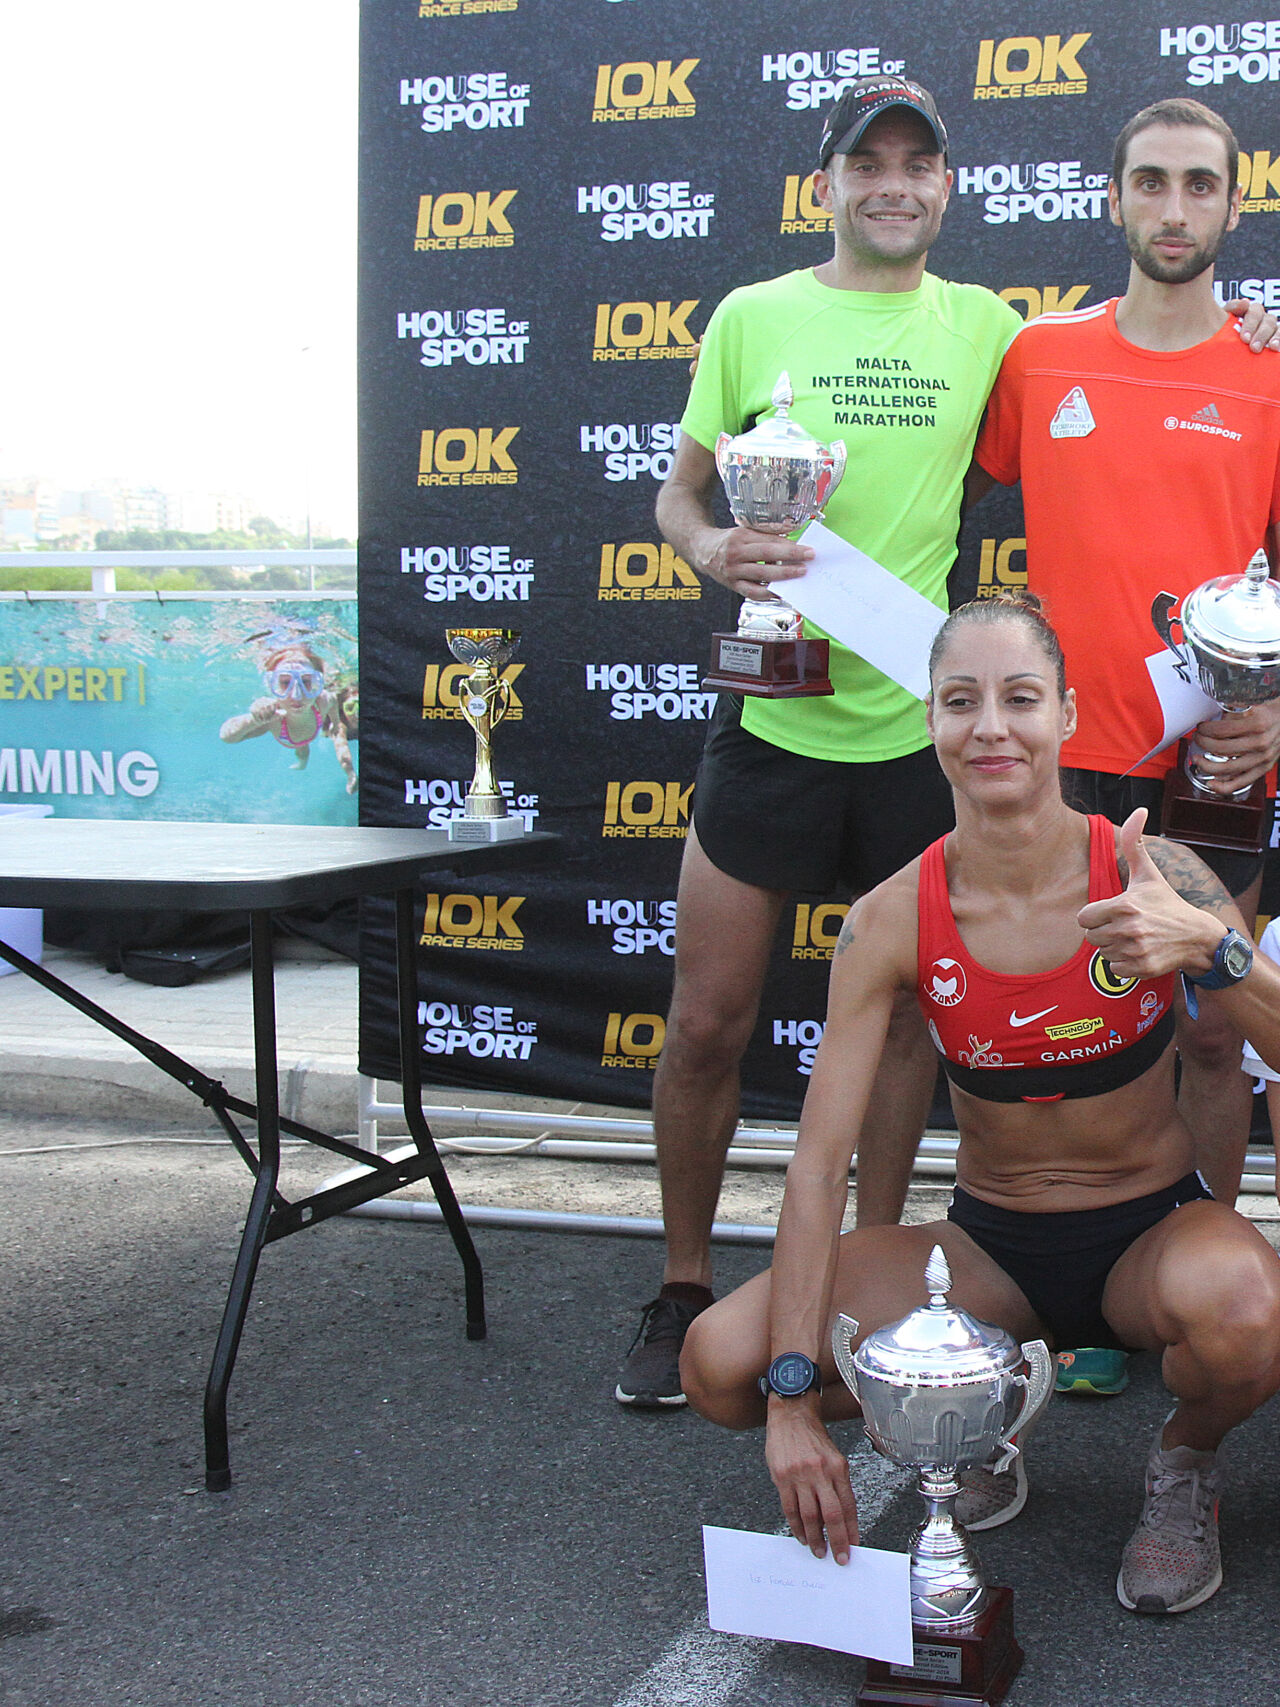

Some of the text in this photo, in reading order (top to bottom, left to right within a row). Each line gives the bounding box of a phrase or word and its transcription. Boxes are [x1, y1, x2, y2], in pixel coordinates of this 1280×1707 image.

[420, 1, 518, 18] RACE SERIES
[762, 48, 906, 82] HOUSE OF
[975, 33, 1093, 86] 10K
[401, 73, 530, 105] HOUSE OF
[593, 58, 700, 107] 10K
[855, 83, 922, 98] GARMIN
[973, 80, 1088, 100] RACE SERIES
[421, 100, 530, 133] SPORT
[592, 105, 696, 123] RACE SERIES
[958, 162, 1108, 194] HOUSE OF
[578, 182, 714, 213] HOUSE OF
[782, 174, 834, 219] 10
[983, 190, 1107, 225] SPORT
[416, 190, 518, 238] 10K
[601, 209, 714, 242] SPORT
[780, 220, 826, 234] RACE
[414, 234, 515, 252] RACE SERIES
[397, 309, 529, 339] HOUSE OF
[594, 299, 700, 349] 10K
[420, 336, 530, 367] SPORT
[593, 345, 695, 361] RACE SERIES
[856, 357, 911, 371] MALTA
[812, 375, 950, 391] INTERNATIONAL
[831, 394, 937, 408] CHALLENGE
[834, 412, 936, 427] MARATHON
[1179, 421, 1242, 441] EUROSPORT
[1191, 414, 1224, 425] adidas
[419, 426, 521, 472] 10K
[581, 423, 680, 452] HOUS
[417, 471, 518, 486] RACE SERIES
[604, 452, 674, 481] SPO
[401, 545, 534, 573] HOUSE OF
[599, 542, 701, 589] 10K
[979, 538, 1028, 584] 10
[424, 573, 534, 603] SPORT
[598, 587, 701, 601] RACE SERIES
[0, 667, 127, 702] EXPERT
[586, 664, 699, 691] HOUSE
[610, 692, 718, 721] SPORT
[0, 749, 160, 797] MING
[517, 795, 539, 807] OF
[604, 781, 695, 825] 10K
[602, 826, 646, 838] RACE
[423, 893, 526, 939] 10K
[587, 900, 677, 926] HOUS
[793, 903, 852, 948] 10
[420, 936, 524, 951] RACE SERIES
[792, 947, 835, 960] RACE
[516, 1021, 537, 1033] OF
[604, 1013, 666, 1057] 10
[422, 1029, 538, 1061] SPORT
[1041, 1035, 1122, 1061] GARMIN
[601, 1056, 646, 1068] RACE
[929, 1650, 958, 1659] SPORT
